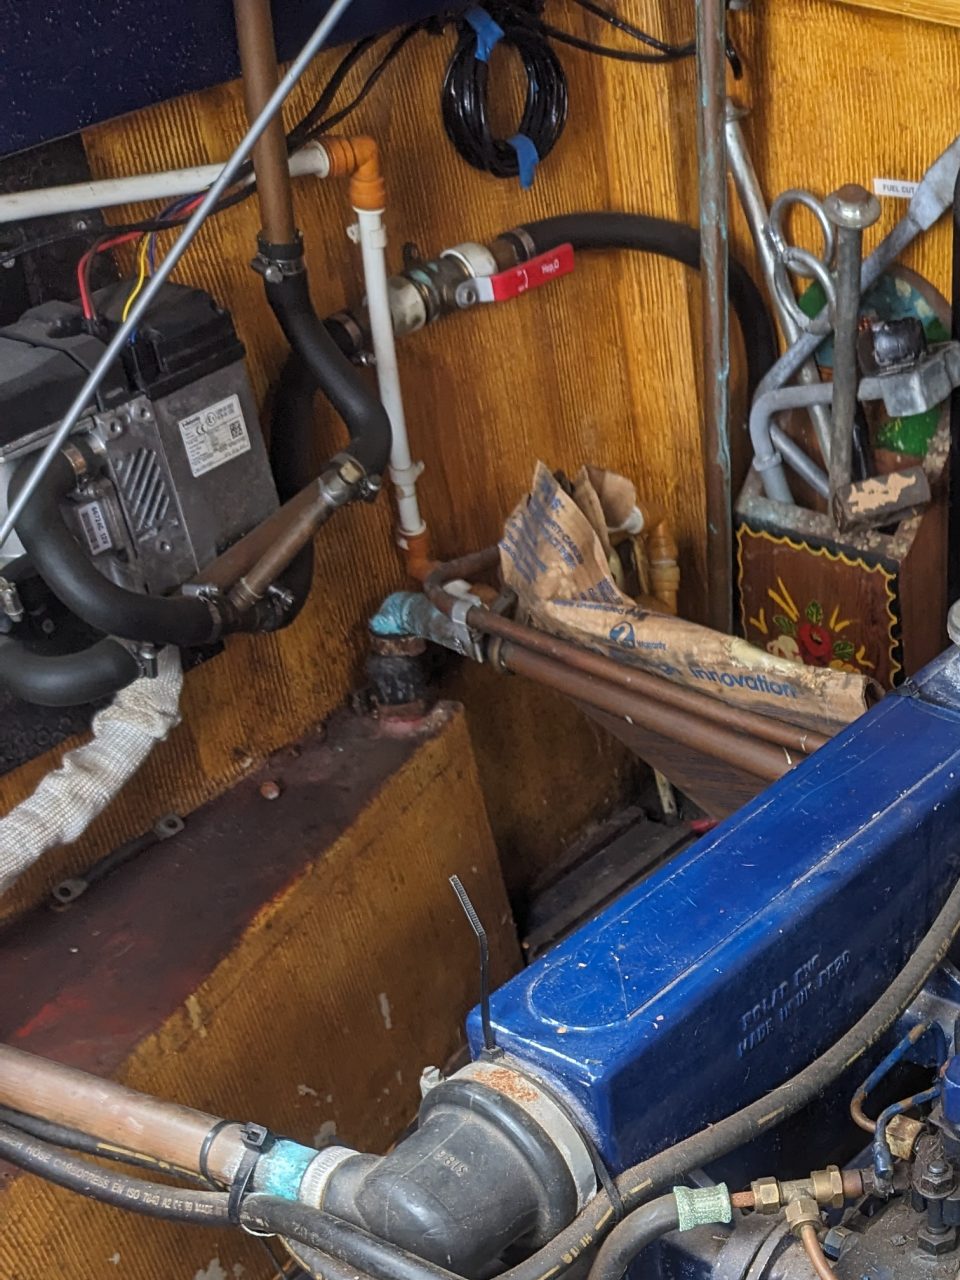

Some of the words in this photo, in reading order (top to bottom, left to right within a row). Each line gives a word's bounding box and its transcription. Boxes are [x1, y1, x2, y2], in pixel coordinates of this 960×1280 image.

[882, 183, 900, 193] FUEL
[689, 665, 798, 699] innovation
[126, 1186, 140, 1200] ISO
